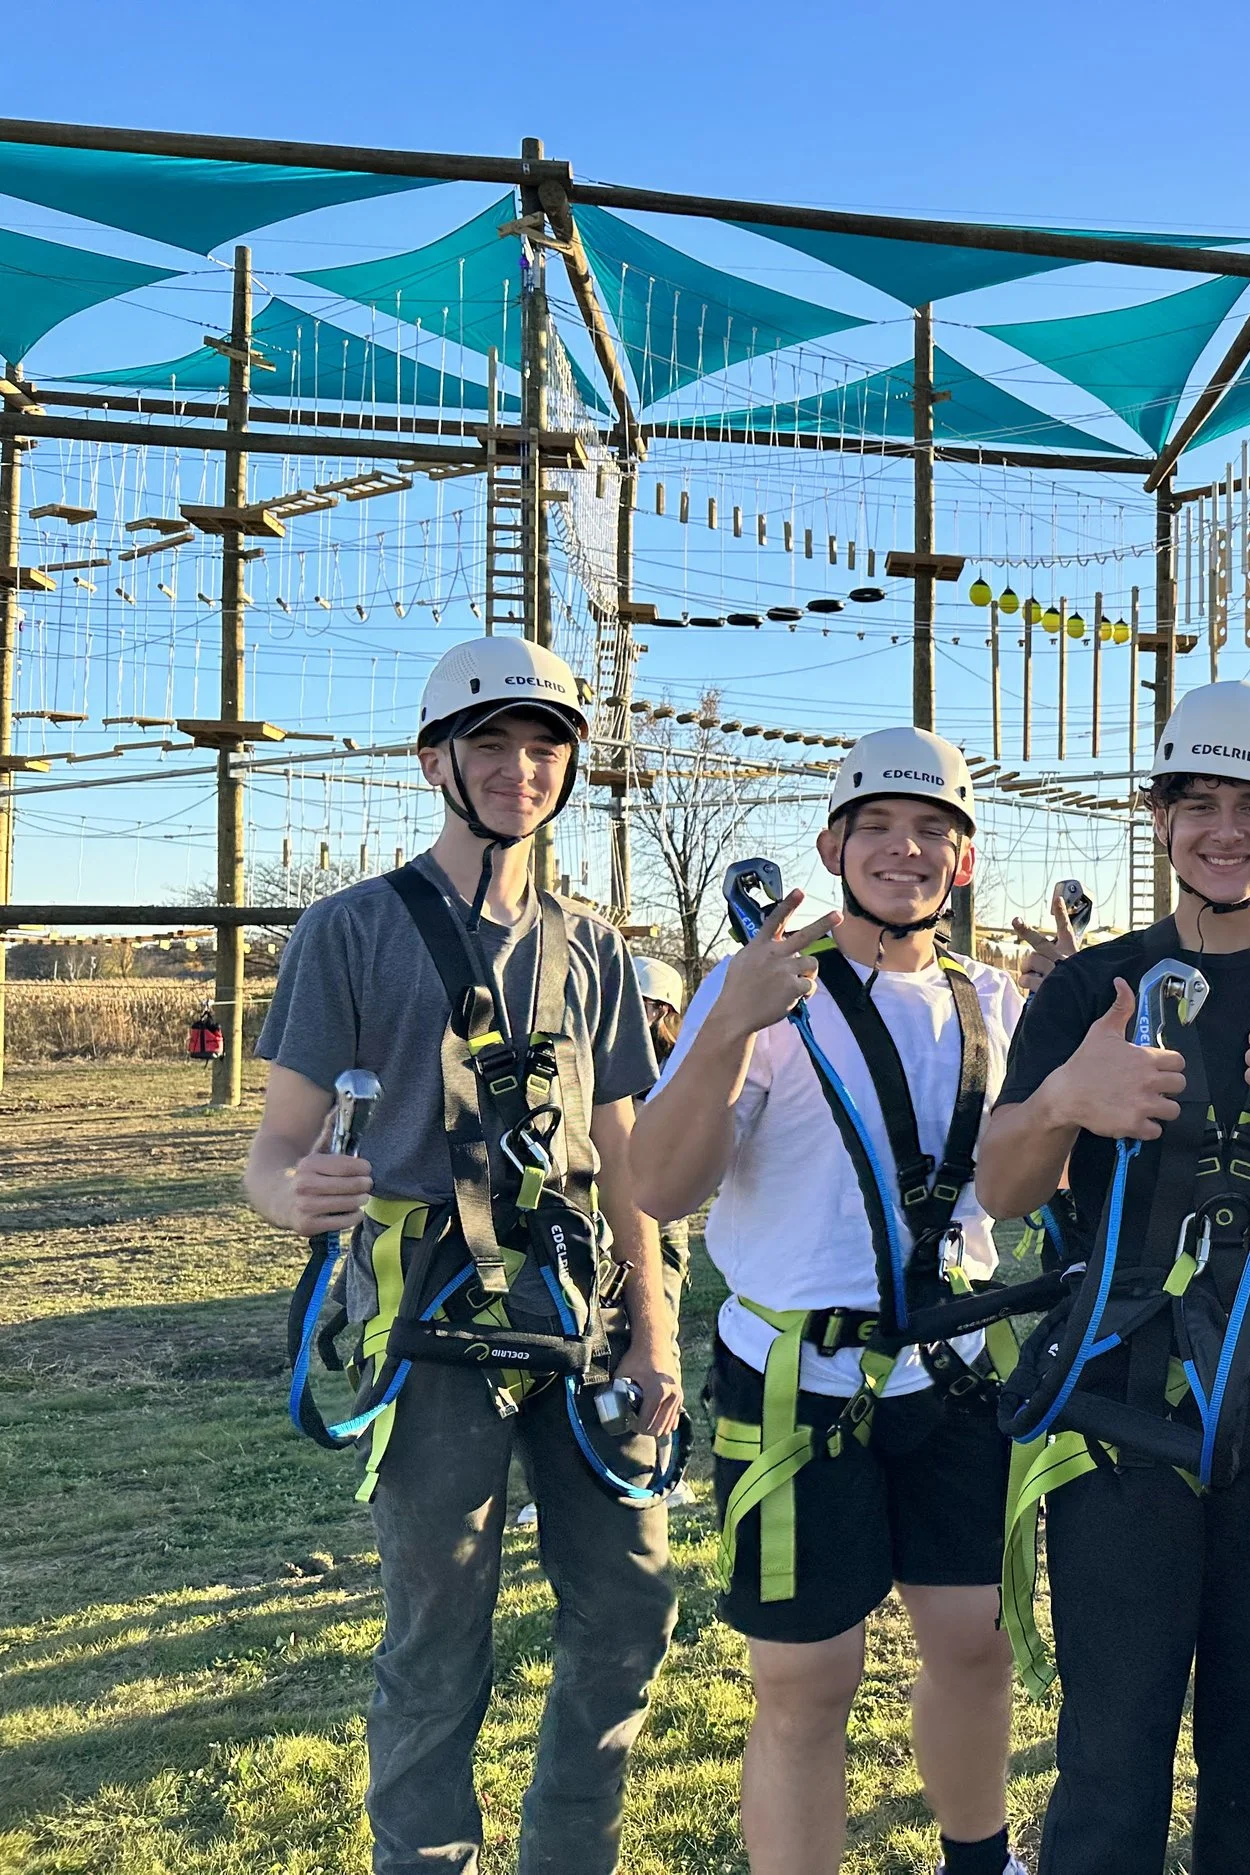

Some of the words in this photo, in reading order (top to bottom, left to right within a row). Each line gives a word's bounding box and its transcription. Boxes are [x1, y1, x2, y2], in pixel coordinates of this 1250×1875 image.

[504, 676, 566, 693] EDELRID
[883, 769, 945, 787] EDELRID
[491, 1348, 531, 1360] EDELRID
